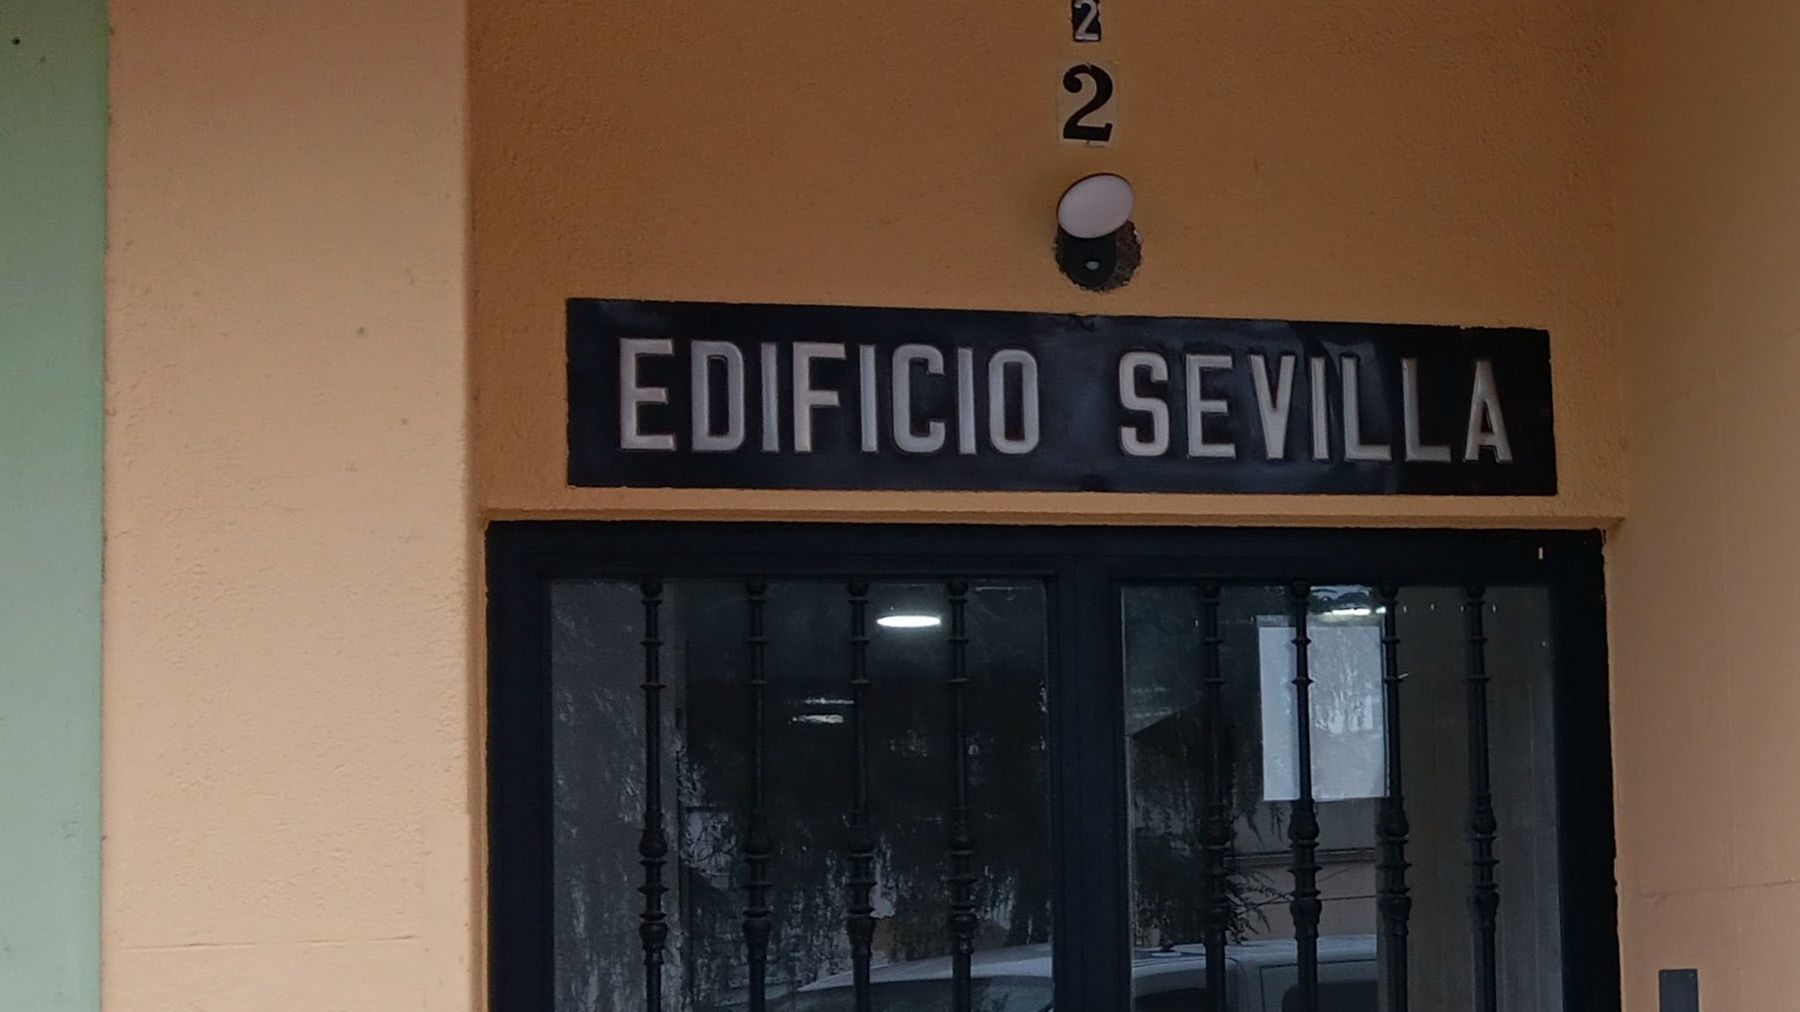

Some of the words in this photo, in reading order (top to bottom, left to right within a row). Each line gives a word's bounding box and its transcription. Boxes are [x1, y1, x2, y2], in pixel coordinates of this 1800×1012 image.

[1073, 0, 1100, 40] 2
[1062, 63, 1113, 142] 2
[618, 337, 1040, 455] EDIFICIO
[1117, 350, 1514, 464] SEVILLA
